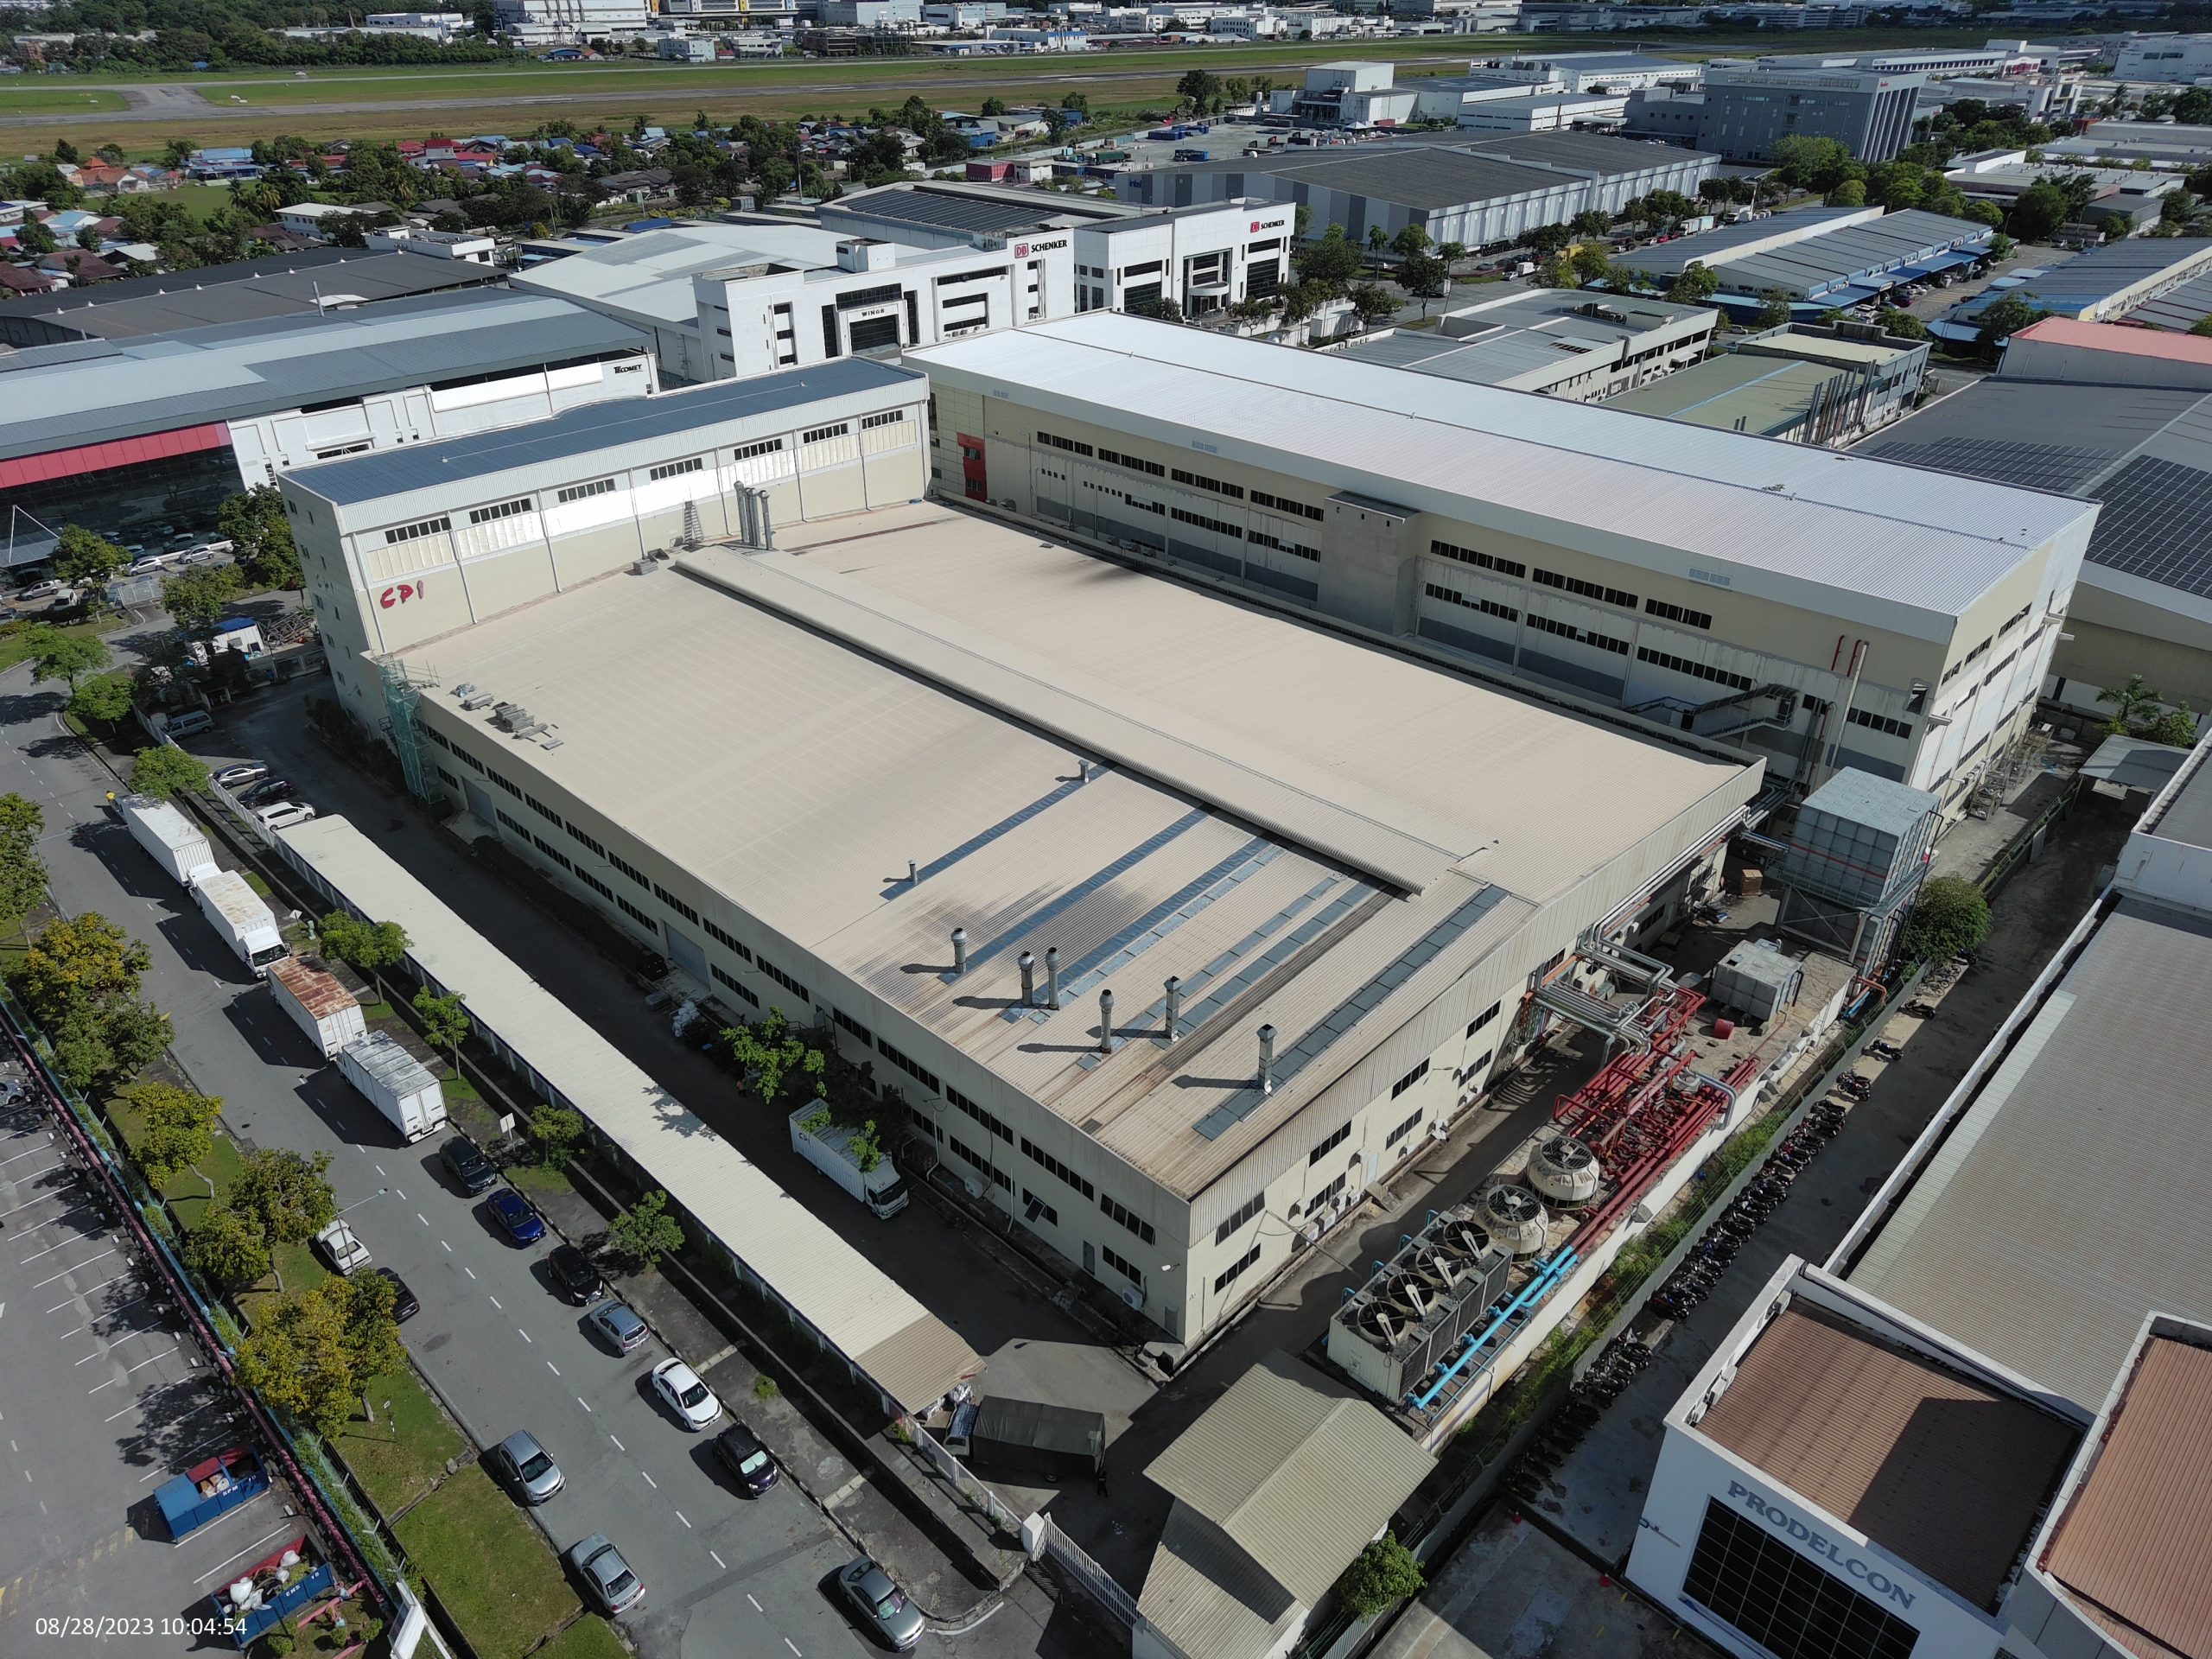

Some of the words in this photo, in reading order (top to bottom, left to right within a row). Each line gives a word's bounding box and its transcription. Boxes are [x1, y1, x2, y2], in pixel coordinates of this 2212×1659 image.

[1016, 245, 1027, 257] DB
[1031, 239, 1067, 253] SCHENKER
[613, 364, 642, 374] TECOMET
[380, 580, 423, 609] CPI
[1727, 1480, 1916, 1610] PRODELCON
